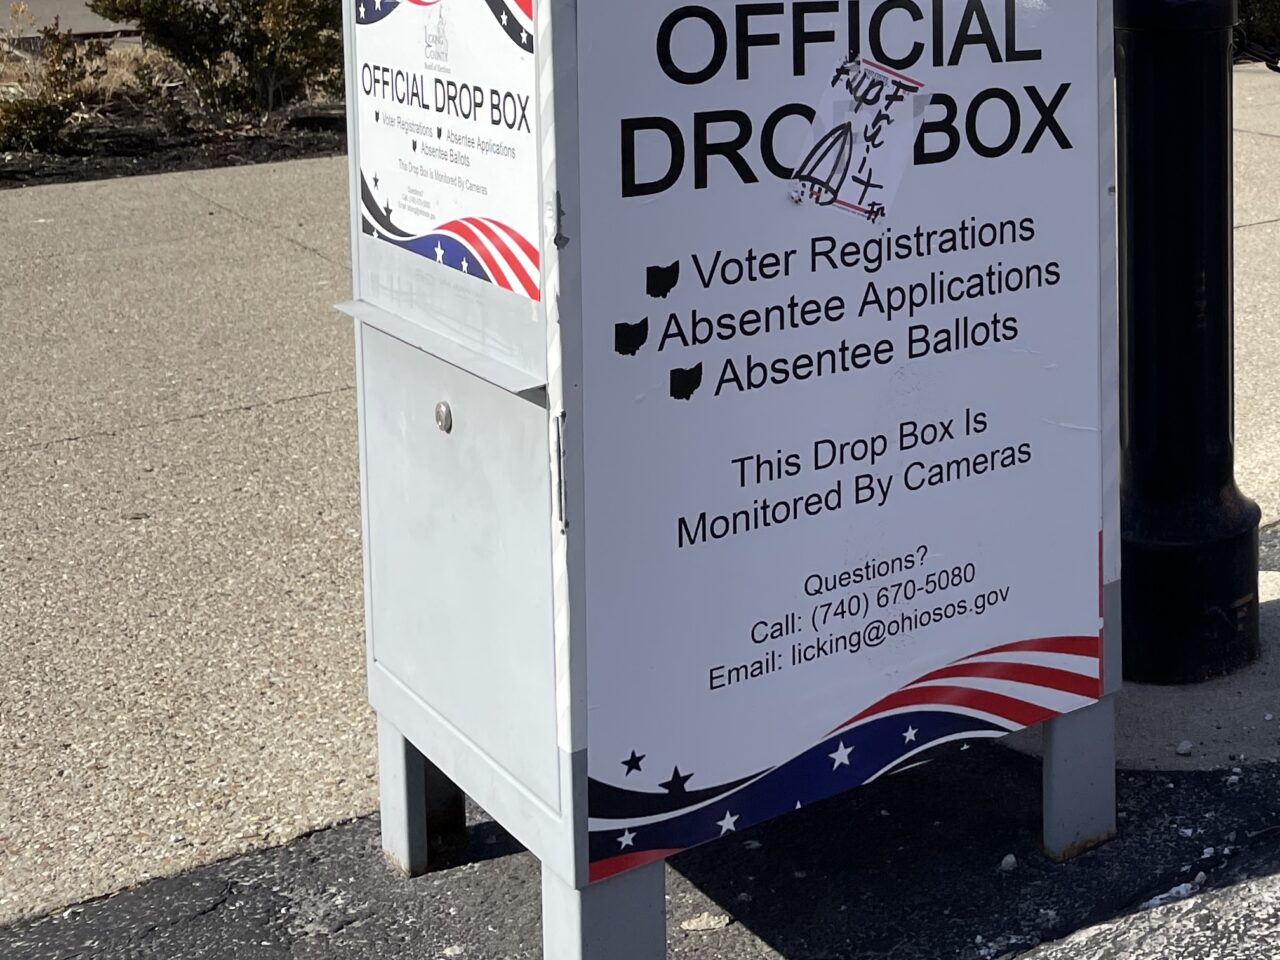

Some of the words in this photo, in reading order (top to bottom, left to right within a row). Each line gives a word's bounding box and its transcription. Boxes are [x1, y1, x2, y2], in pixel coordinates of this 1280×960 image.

[361, 62, 430, 110] OFFICIAL
[434, 77, 484, 122] DROP
[489, 88, 531, 134] BOX
[382, 111, 396, 127] Voter
[396, 115, 433, 138] Registrations
[421, 140, 448, 161] Absentee
[449, 148, 470, 168] Ballots
[446, 128, 475, 149] Absentee
[476, 136, 516, 160] Applications
[620, 102, 818, 199] DRO
[913, 82, 1074, 166] BOX
[691, 247, 798, 289] Voter
[811, 216, 1035, 274] Registrations
[657, 294, 846, 352] Absentee
[857, 261, 1061, 322] Applications
[713, 339, 894, 397] Absentee
[908, 312, 1019, 359] Ballots
[731, 450, 801, 488] This
[814, 434, 888, 471] Drop
[899, 418, 955, 451] Box
[965, 407, 988, 436] Is
[678, 480, 842, 549] Monitored
[854, 473, 894, 507] By
[903, 442, 1032, 491] Cameras
[750, 611, 802, 644] Call:
[811, 592, 869, 633] (740)
[876, 562, 976, 608] 670-5080
[804, 544, 929, 597] Questions?
[708, 650, 783, 690] Email:
[791, 586, 1010, 666] licking@ohiosos.gov
